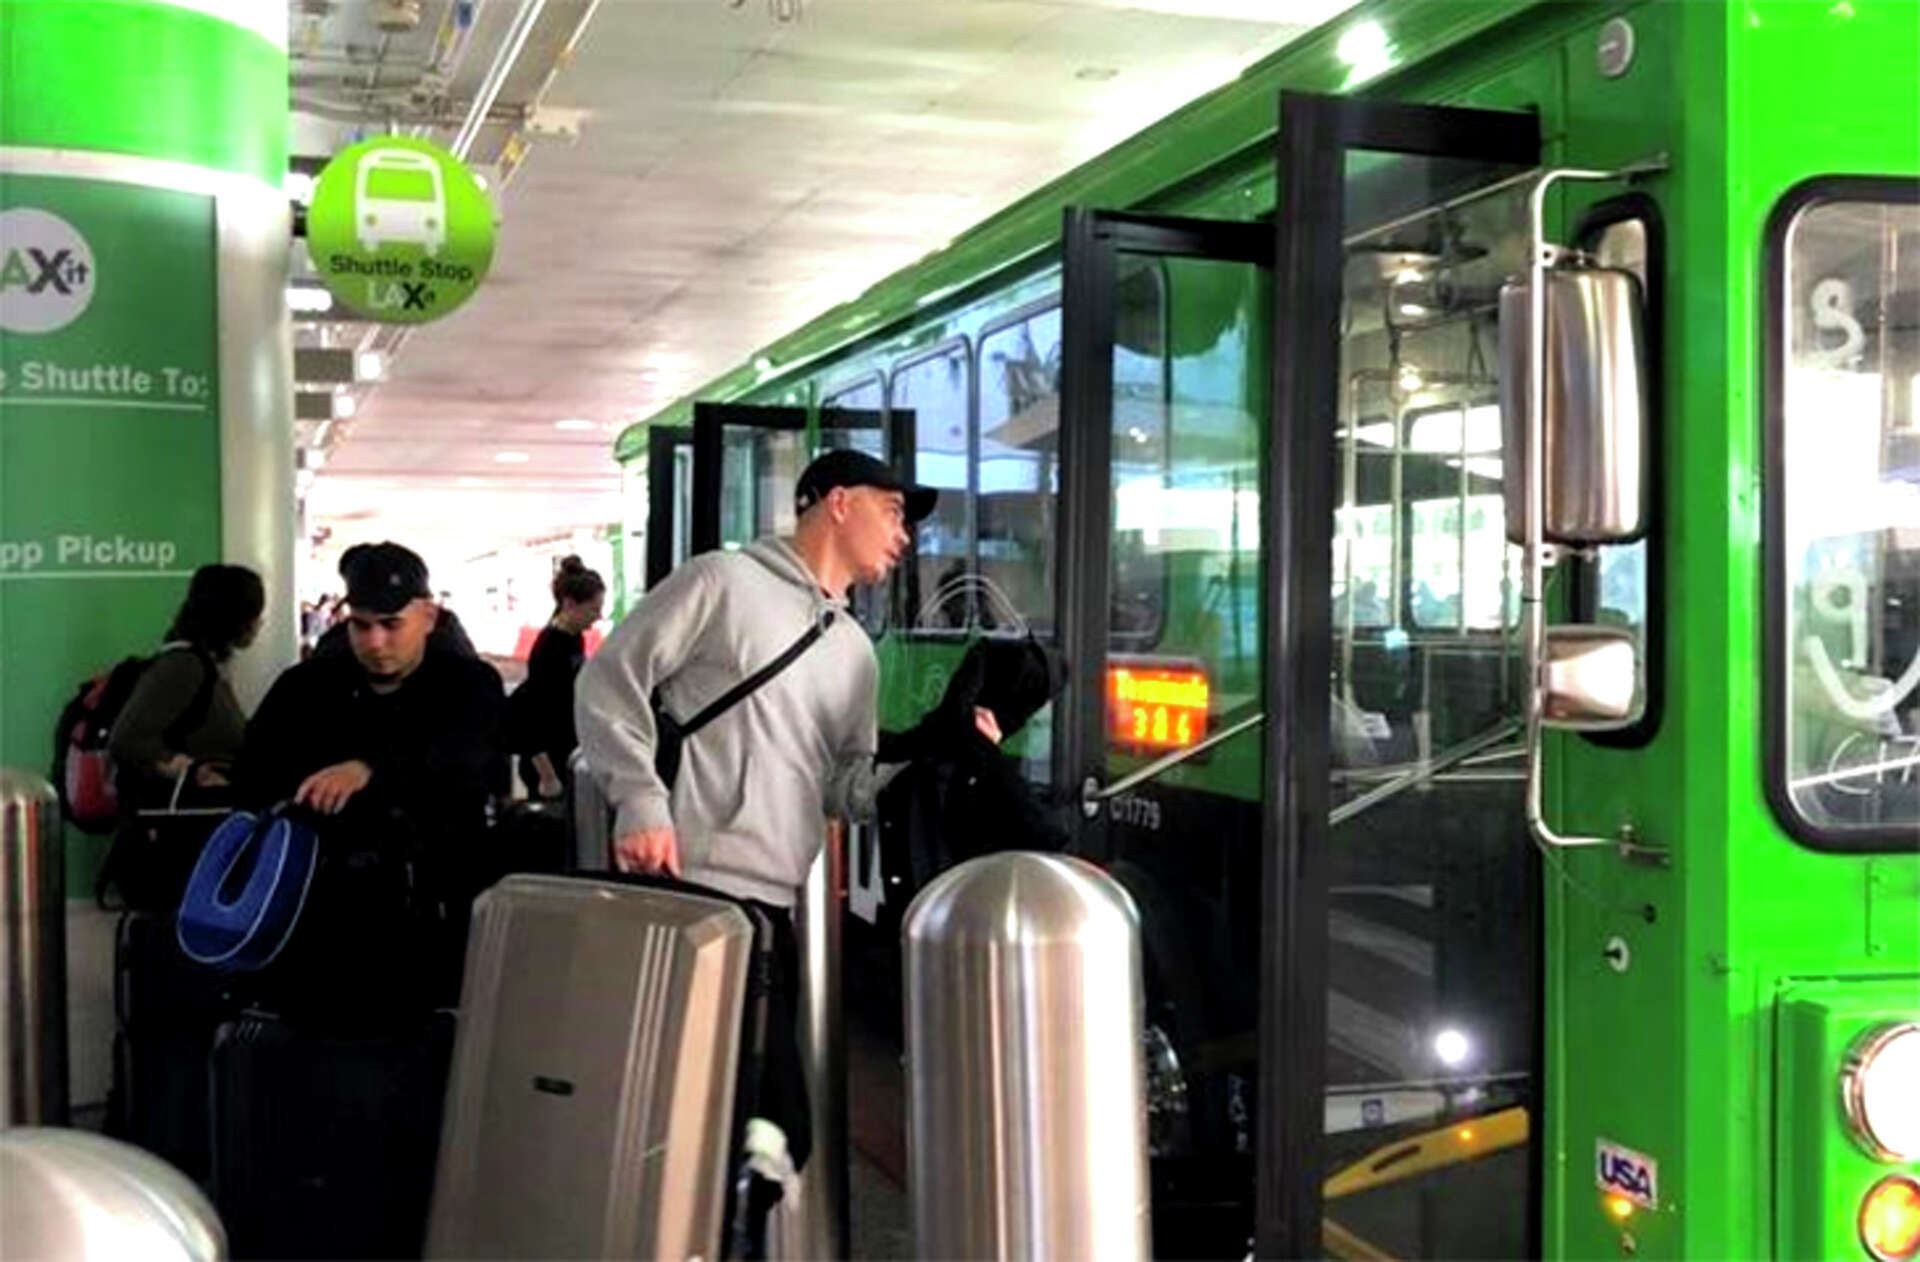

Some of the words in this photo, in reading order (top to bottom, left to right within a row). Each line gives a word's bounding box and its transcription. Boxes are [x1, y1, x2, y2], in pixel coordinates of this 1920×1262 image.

[330, 254, 413, 277] Shuttle
[419, 257, 473, 283] Stop
[20, 361, 152, 394] Shuttle
[162, 367, 209, 397] To:
[56, 534, 177, 568] Pickup
[1600, 1150, 1653, 1200] USA
